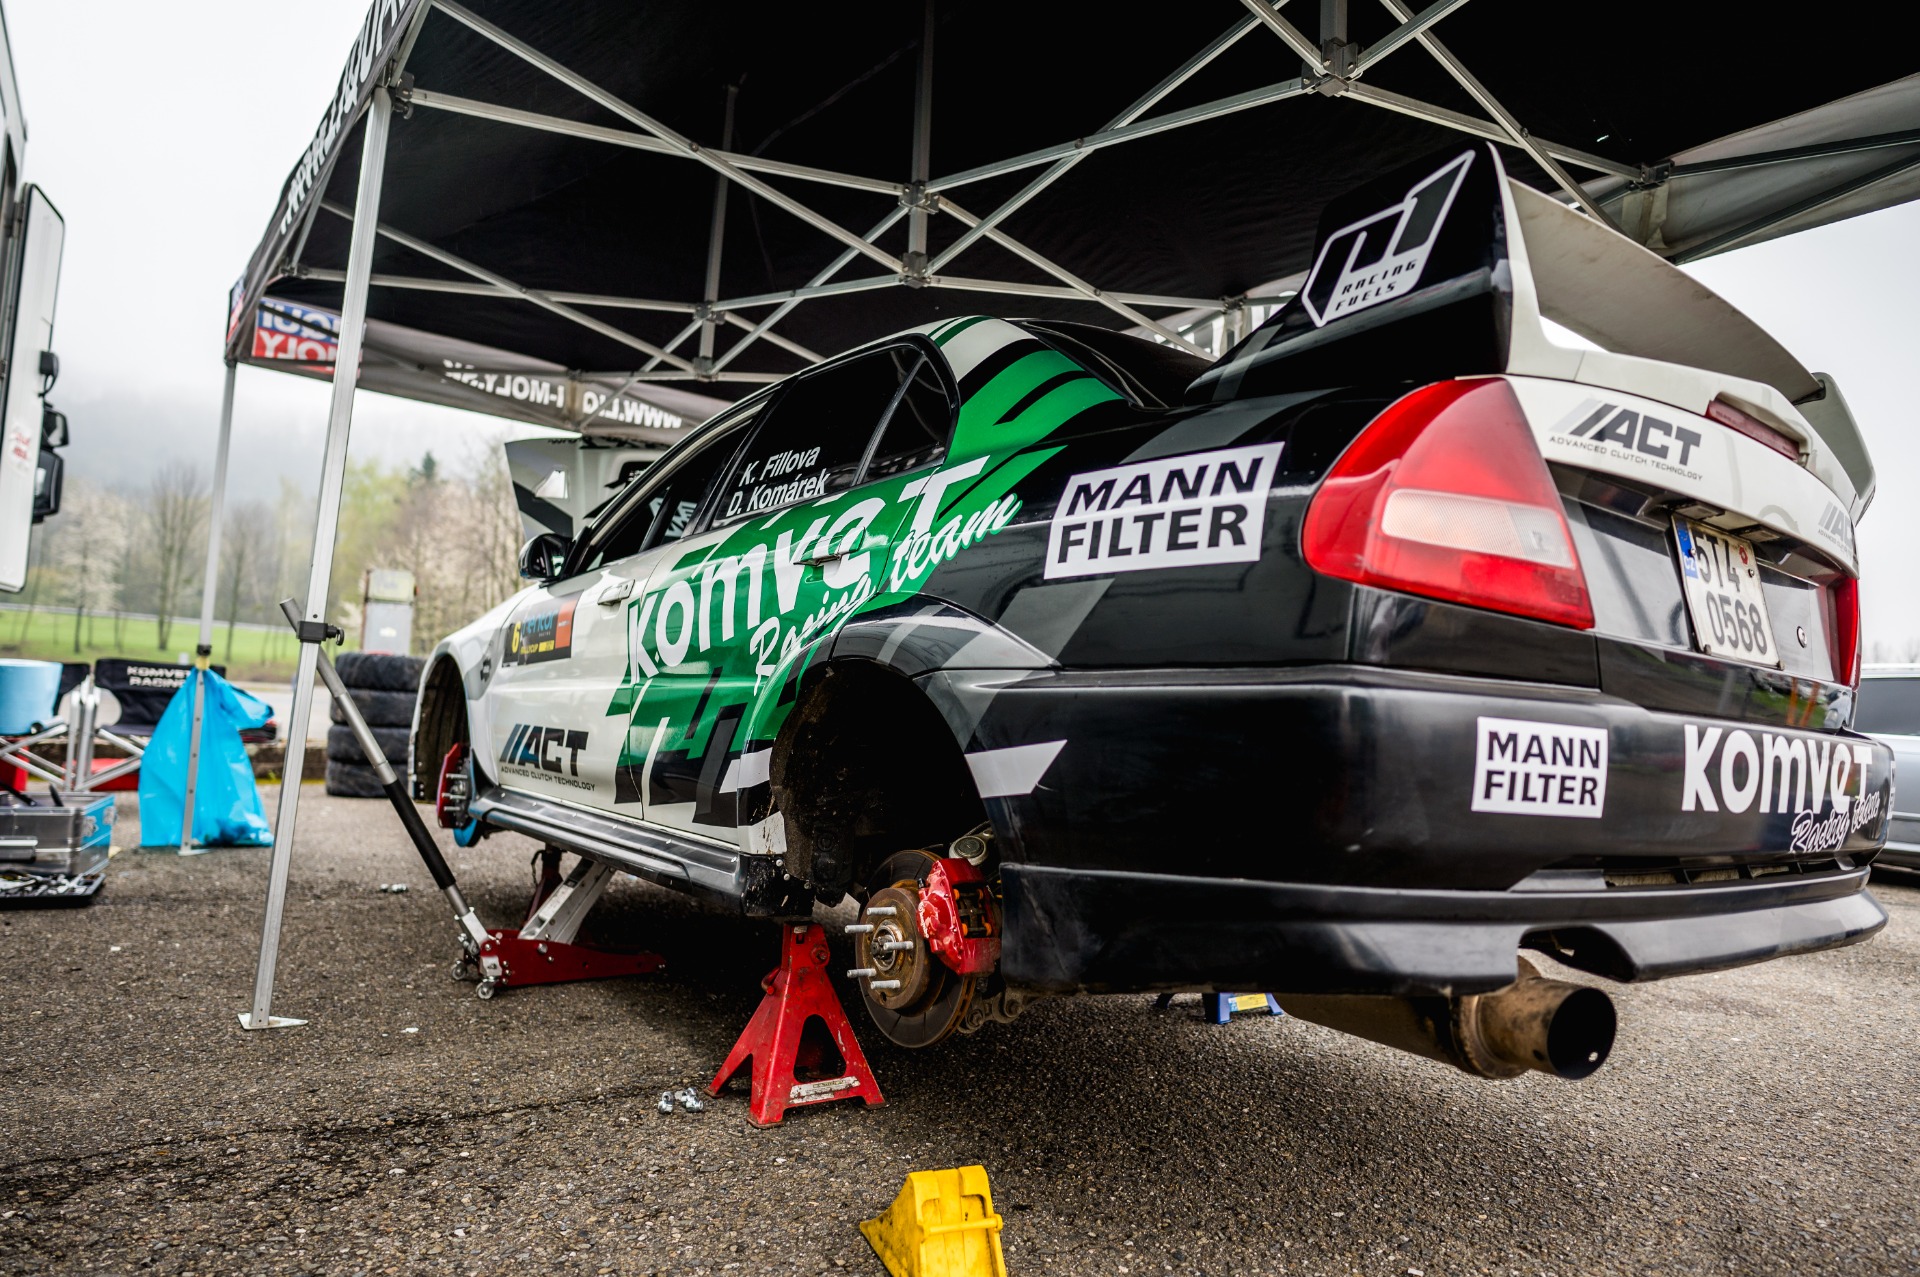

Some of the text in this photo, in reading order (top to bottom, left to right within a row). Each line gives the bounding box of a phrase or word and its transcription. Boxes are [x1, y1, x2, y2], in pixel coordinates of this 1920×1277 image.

[1335, 281, 1396, 311] FUELS
[1342, 259, 1417, 295] RACING
[1549, 436, 1703, 482] ADVANCED CLUTCH TECHNOLOGY
[1590, 408, 1702, 467] ACT
[739, 446, 821, 487] K. Fillova
[1066, 457, 1264, 516] MANN
[726, 490, 743, 517] D.
[747, 468, 831, 512] Komárek
[1057, 504, 1248, 564] FILTER
[1684, 558, 1696, 571] CZ
[1691, 528, 1740, 592] 5T4
[750, 493, 1023, 697] Racing team
[1706, 591, 1768, 655] 0568
[518, 725, 588, 777] ACT
[1487, 730, 1600, 769] MANN
[501, 766, 595, 791] ADVANCED CLUTCH TECHNOLOGY
[1483, 769, 1598, 806] FILTER
[1789, 808, 1851, 852] Racing
